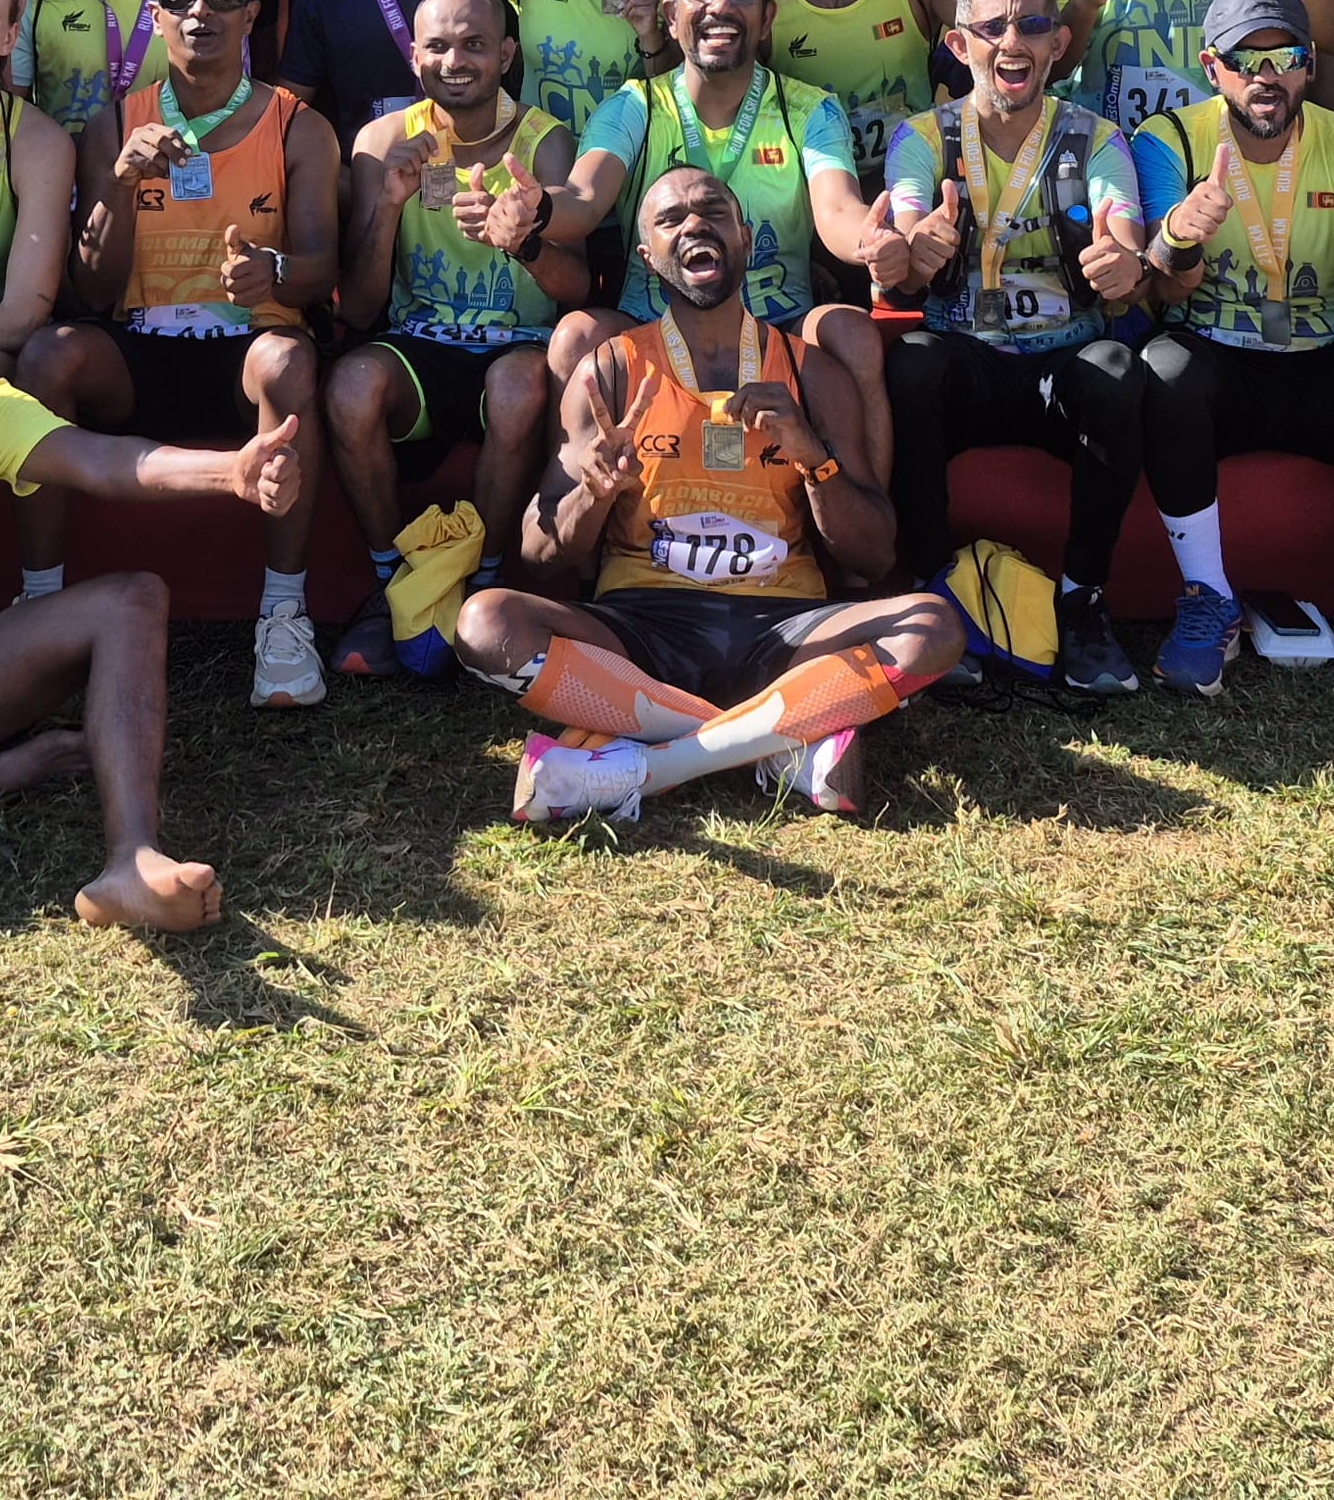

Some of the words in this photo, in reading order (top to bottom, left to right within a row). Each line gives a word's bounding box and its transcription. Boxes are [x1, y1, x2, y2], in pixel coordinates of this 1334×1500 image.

[139, 9, 153, 32] RUN
[388, 9, 403, 31] RUN
[120, 79, 128, 88] 5
[124, 61, 137, 78] KM
[750, 66, 766, 100] LANKA
[746, 100, 758, 117] SRI
[736, 116, 752, 138] FOR
[967, 121, 979, 145] SRI
[729, 137, 743, 158] RUN
[969, 145, 981, 168] FOR
[1280, 147, 1294, 167] FOR
[972, 167, 985, 189] RUN
[1010, 168, 1024, 190] RUN
[1021, 145, 1037, 168] FOR
[1228, 157, 1243, 177] FOR
[1233, 179, 1251, 202] RUN
[1277, 172, 1293, 193] RUN
[1248, 224, 1265, 242] KM
[1273, 218, 1287, 234] KM
[154, 252, 225, 267] RUNNI
[673, 348, 688, 367] FOR
[746, 338, 758, 360] SRI
[680, 367, 696, 389] RUN
[742, 360, 757, 381] FOR
[640, 434, 681, 453] CCR
[684, 532, 756, 576] 178
